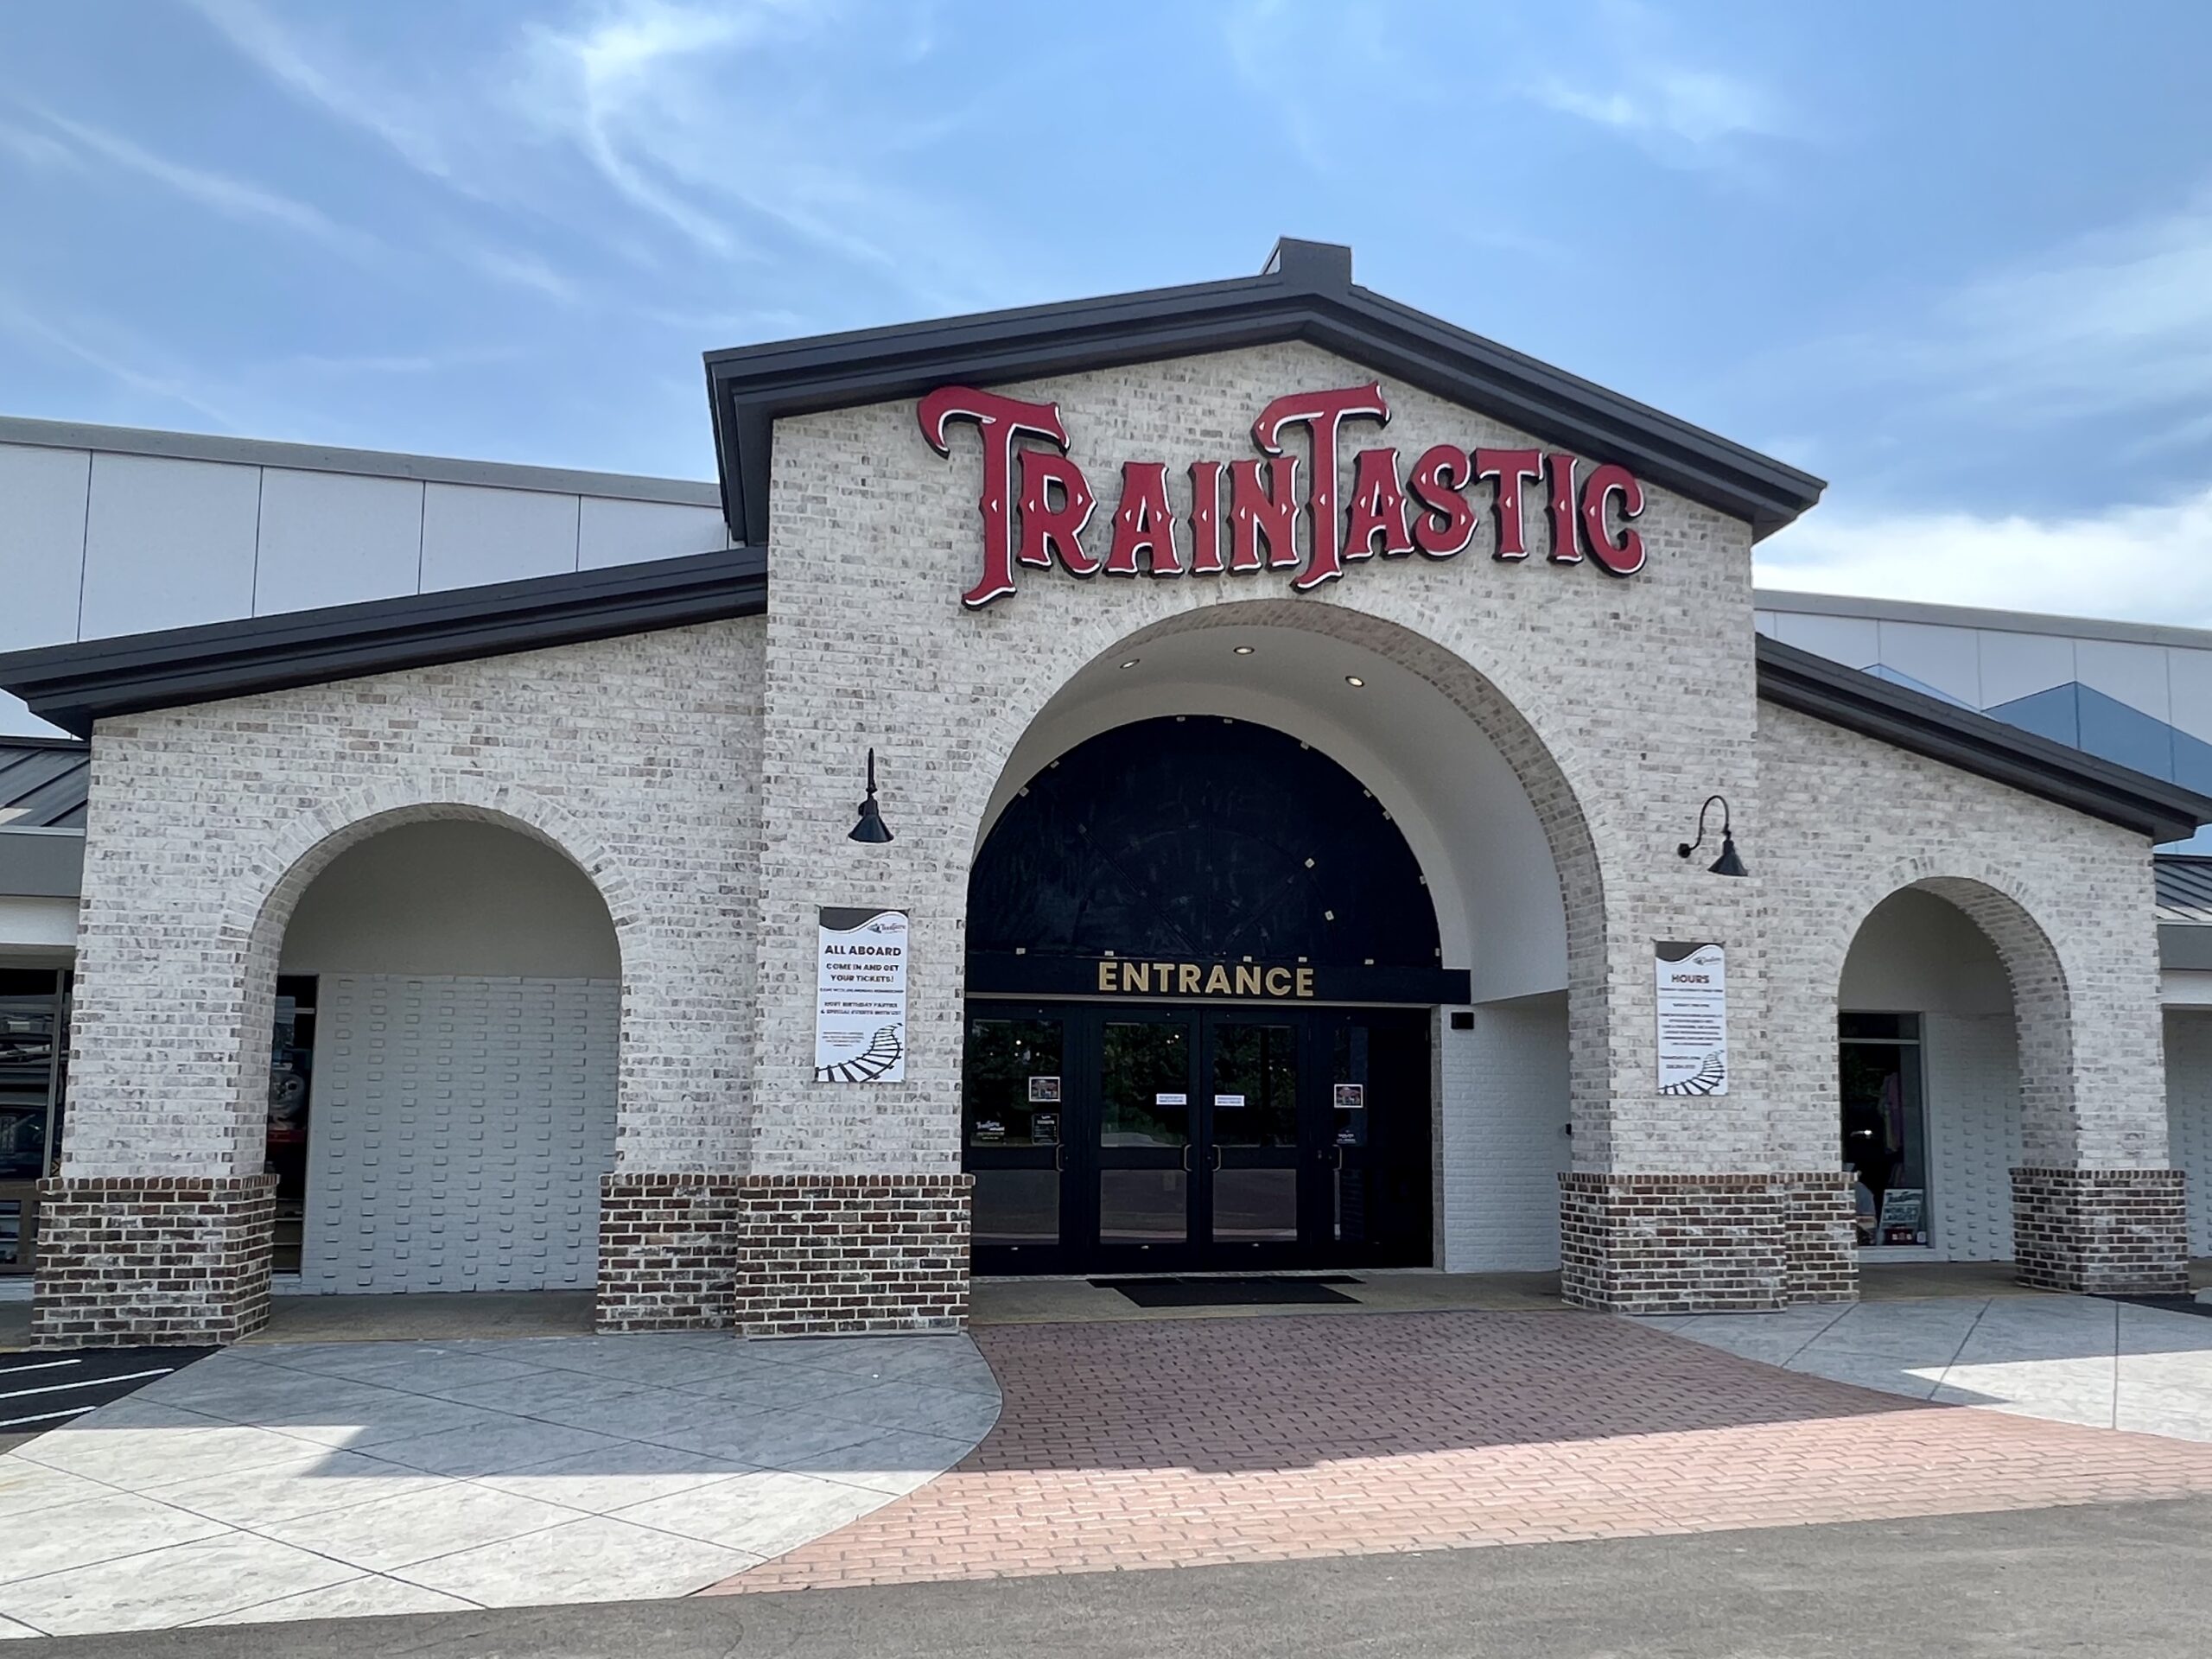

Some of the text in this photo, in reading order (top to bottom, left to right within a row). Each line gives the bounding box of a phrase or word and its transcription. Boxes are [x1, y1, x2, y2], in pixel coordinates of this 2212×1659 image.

[824, 944, 902, 957] ALL ABOARD
[1098, 961, 1314, 997] ENTRANCE
[1670, 974, 1710, 984] HOURS
